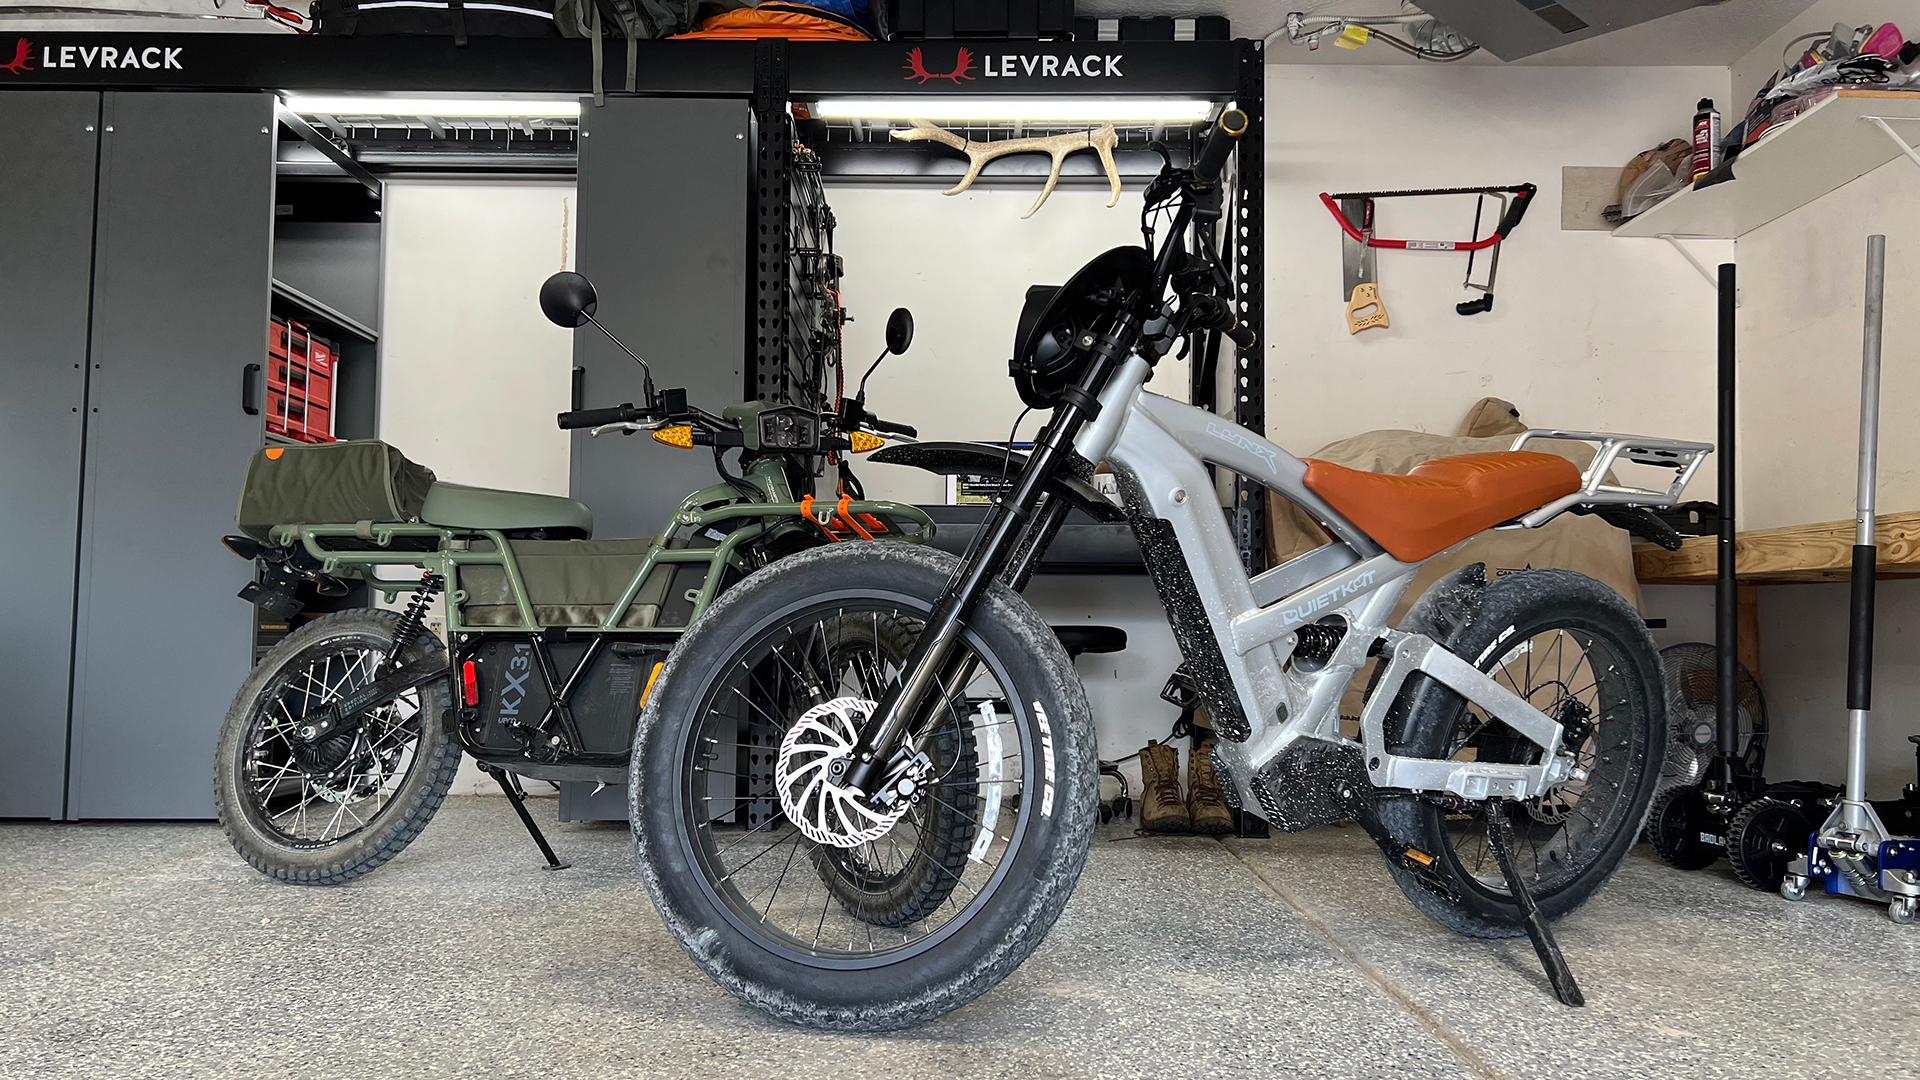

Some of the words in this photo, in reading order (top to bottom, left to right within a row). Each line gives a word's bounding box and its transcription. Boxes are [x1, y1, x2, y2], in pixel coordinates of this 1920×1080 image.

[43, 46, 183, 69] LEVRACK
[984, 55, 1124, 77] LEVRACK
[1205, 421, 1277, 475] LYNX
[1279, 569, 1376, 625] QUIETKAT
[1032, 700, 1052, 735] VEE
[1041, 735, 1055, 784] TIRE
